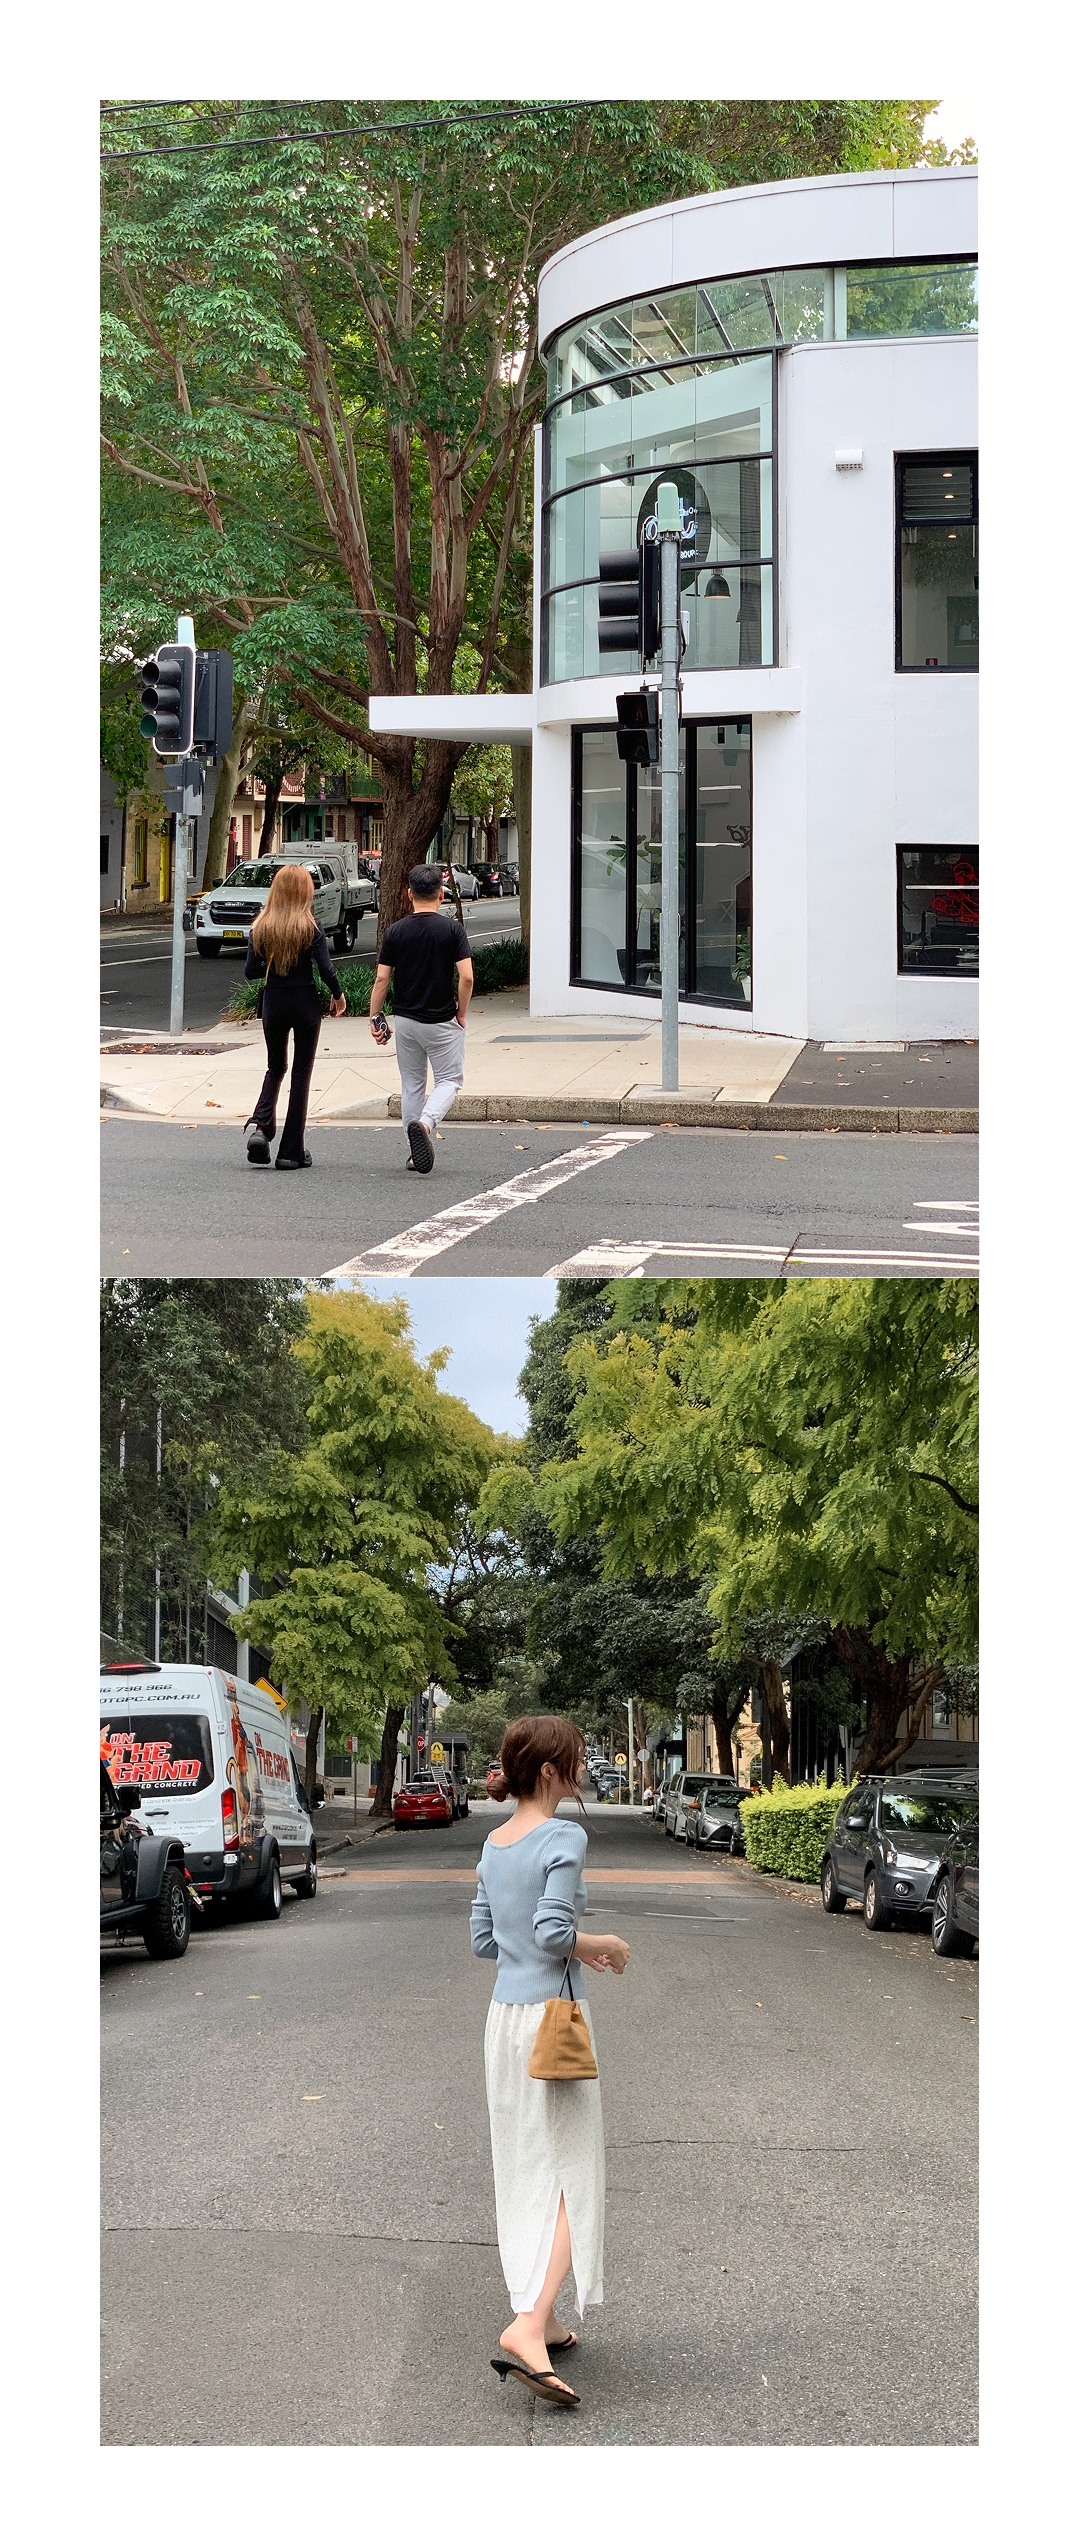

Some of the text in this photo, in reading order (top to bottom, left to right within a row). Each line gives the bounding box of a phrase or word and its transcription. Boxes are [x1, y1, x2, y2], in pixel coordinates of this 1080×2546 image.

[110, 1732, 136, 1744] ON
[111, 1742, 172, 1763] THE
[256, 1747, 273, 1778] THE
[114, 1759, 202, 1783] GRIND
[154, 1781, 198, 1789] CONCRETE
